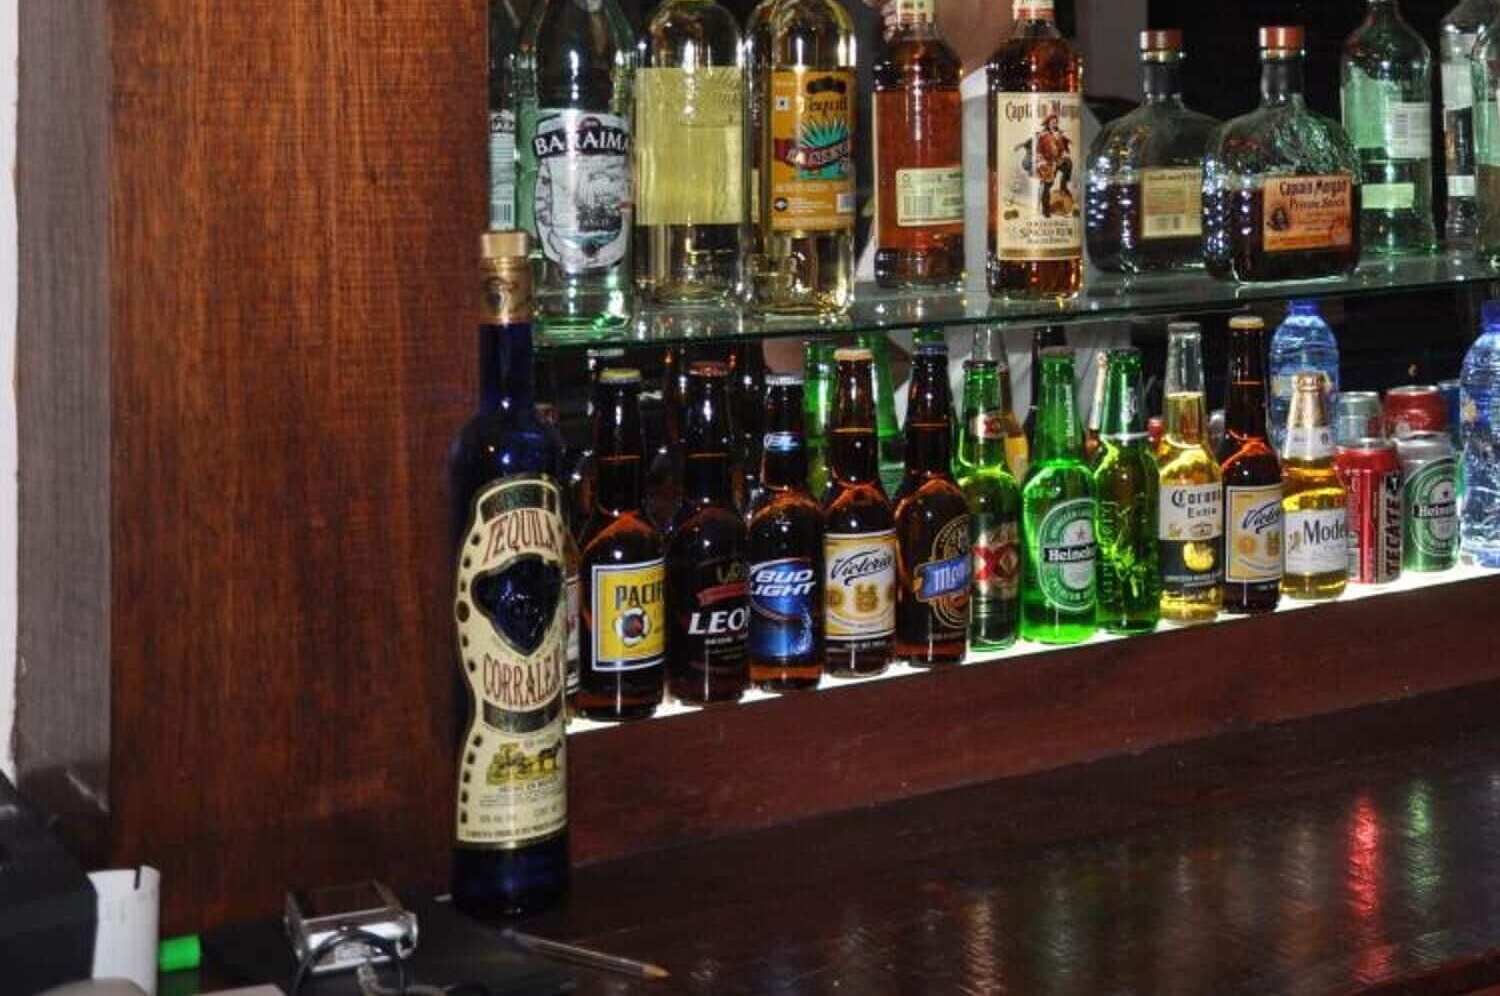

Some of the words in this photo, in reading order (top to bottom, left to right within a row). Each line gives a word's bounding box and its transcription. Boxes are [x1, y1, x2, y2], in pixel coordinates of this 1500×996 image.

[1006, 101, 1048, 122] Captin
[482, 509, 560, 567] TEQUILA
[1303, 518, 1347, 546] Mode
[1385, 497, 1402, 577] TECATE
[755, 569, 814, 583] BUD
[615, 581, 664, 610] PACIF
[483, 653, 562, 707] CORRALEJ
